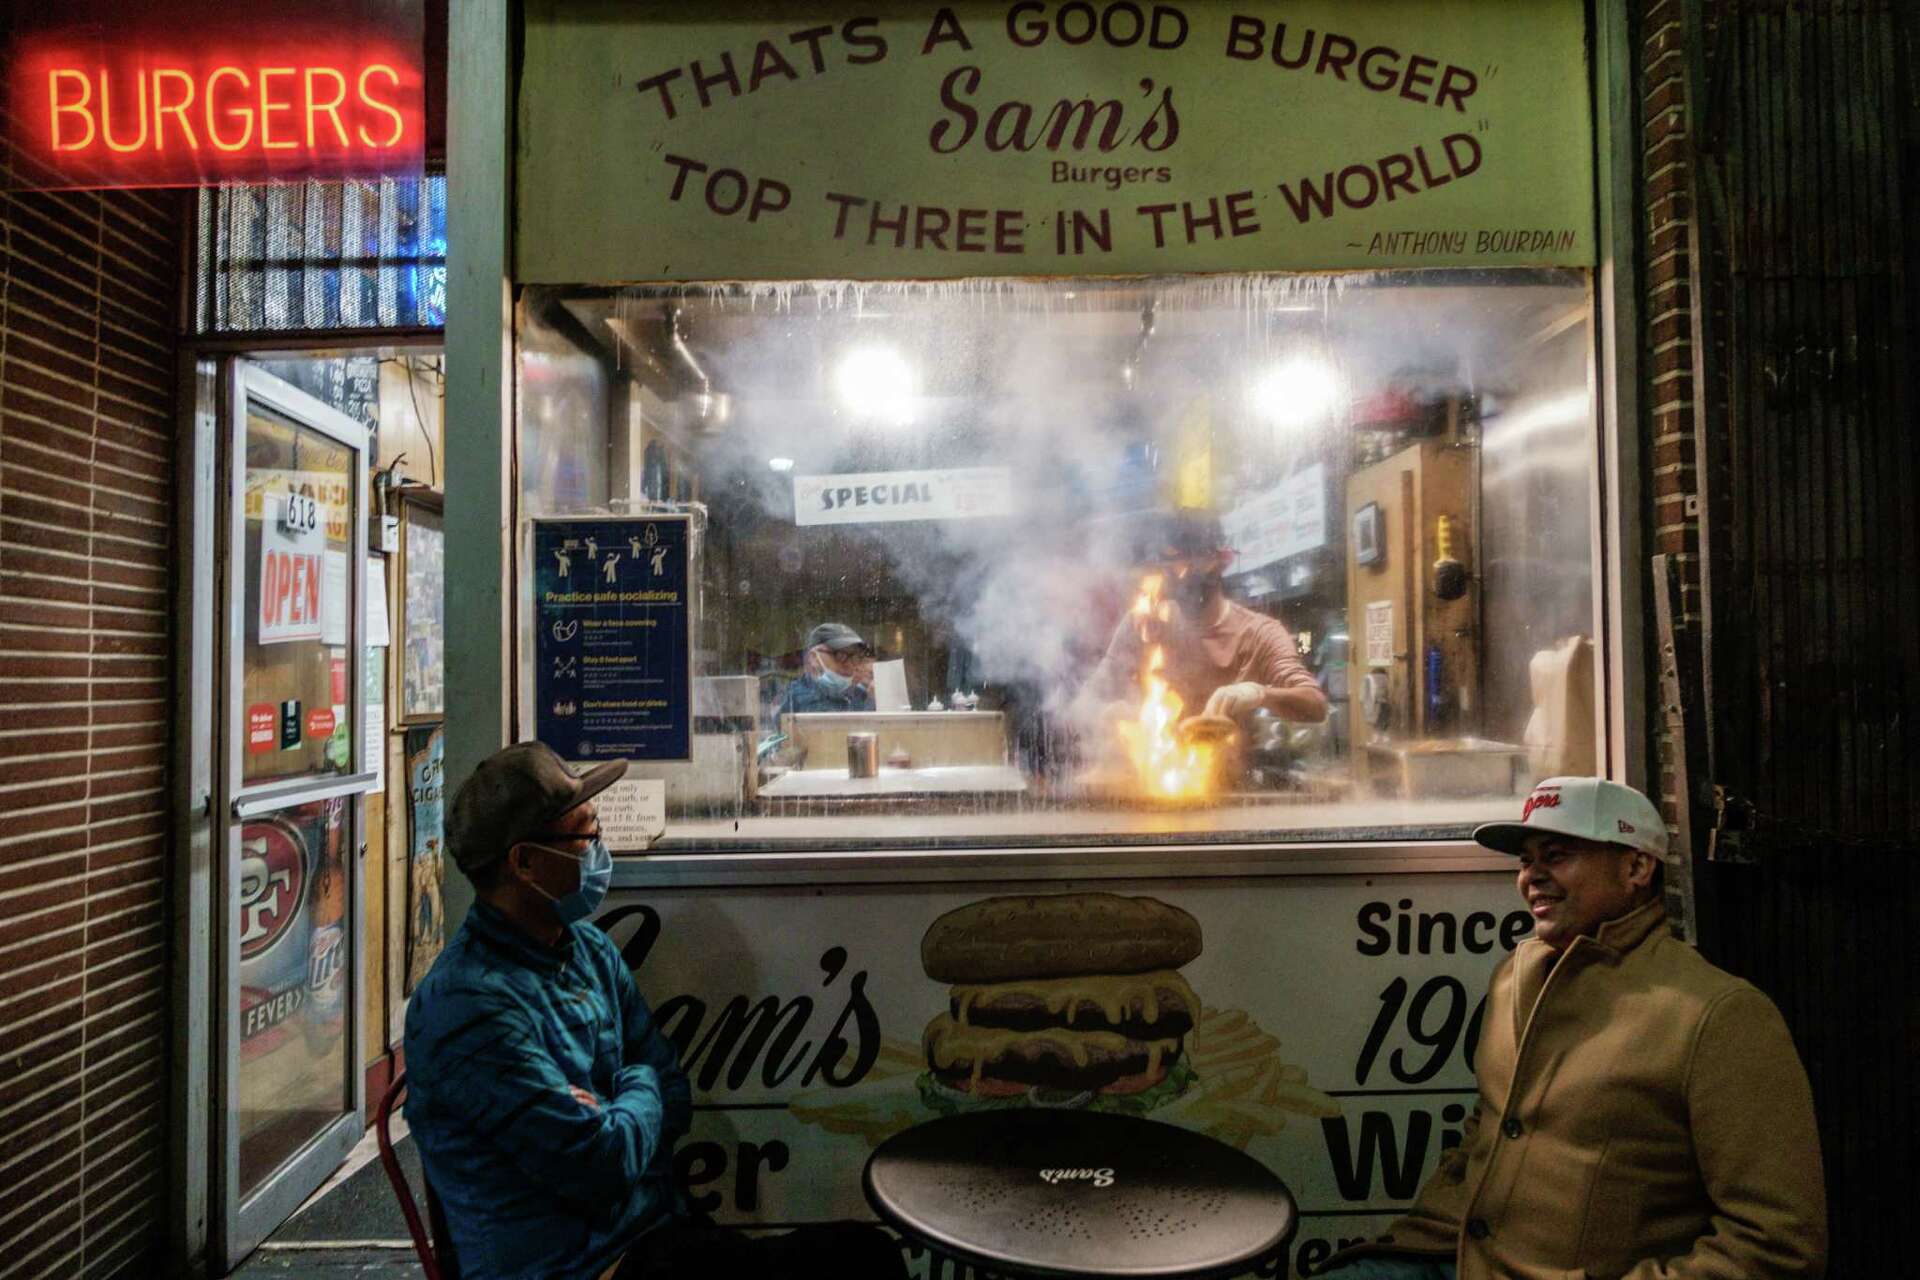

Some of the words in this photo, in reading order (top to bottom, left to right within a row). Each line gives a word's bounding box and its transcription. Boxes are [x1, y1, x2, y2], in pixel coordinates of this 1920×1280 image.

[921, 6, 973, 55] A
[1006, 1, 1190, 51] GOOD
[48, 63, 404, 152] BURGERS
[929, 64, 1181, 154] Sam's
[1051, 160, 1172, 191] Burgers
[825, 191, 1026, 257] THREE
[1056, 208, 1113, 257] IN
[1136, 189, 1262, 249] THE
[1476, 229, 1576, 256] BOURDAIN
[288, 495, 316, 531] 618
[820, 482, 934, 511] SPECIAL
[262, 551, 321, 627] OPEN
[545, 590, 592, 602] Practice
[1355, 897, 1536, 957] Since
[1039, 1167, 1115, 1187] Sam's
